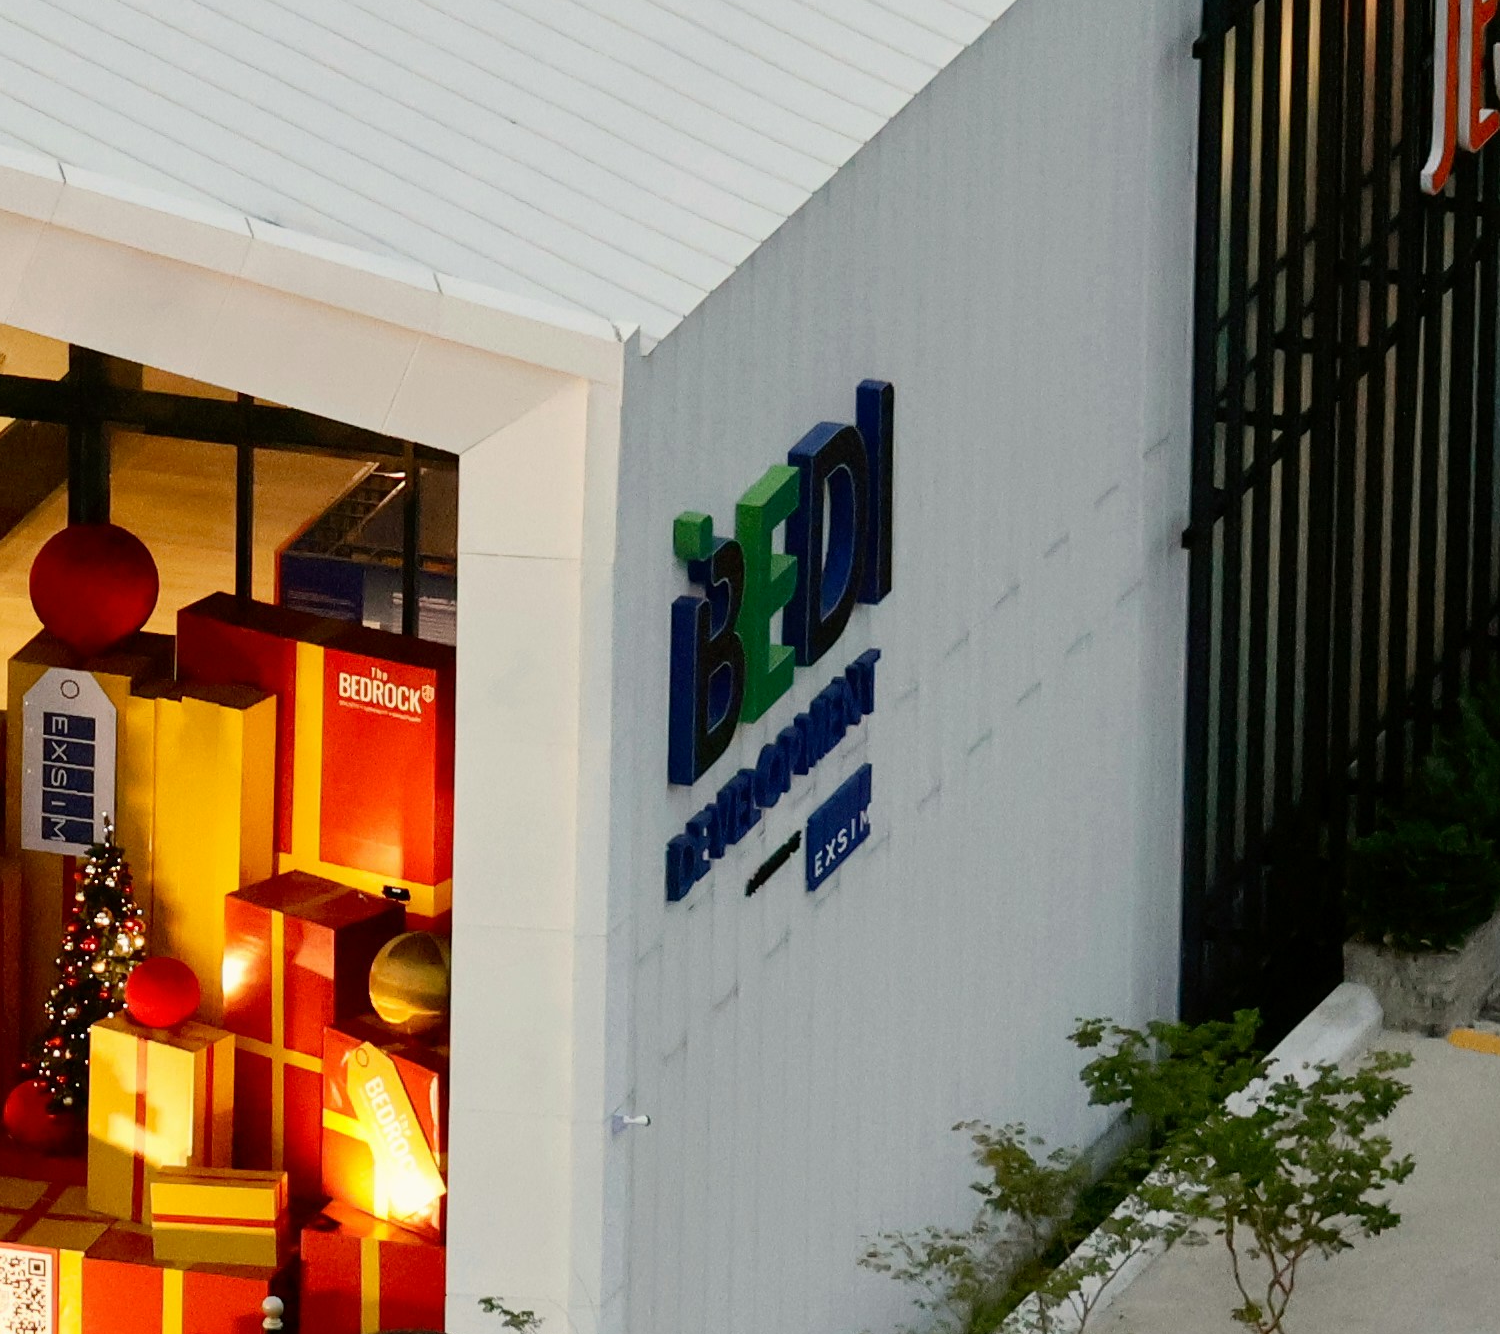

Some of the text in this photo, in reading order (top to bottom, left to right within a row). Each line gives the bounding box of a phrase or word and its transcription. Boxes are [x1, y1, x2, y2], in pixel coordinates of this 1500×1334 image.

[667, 379, 895, 786] BEDI
[339, 672, 422, 715] BEDROCK
[50, 715, 69, 843] EXSIM
[364, 1075, 416, 1171] BEDROC
